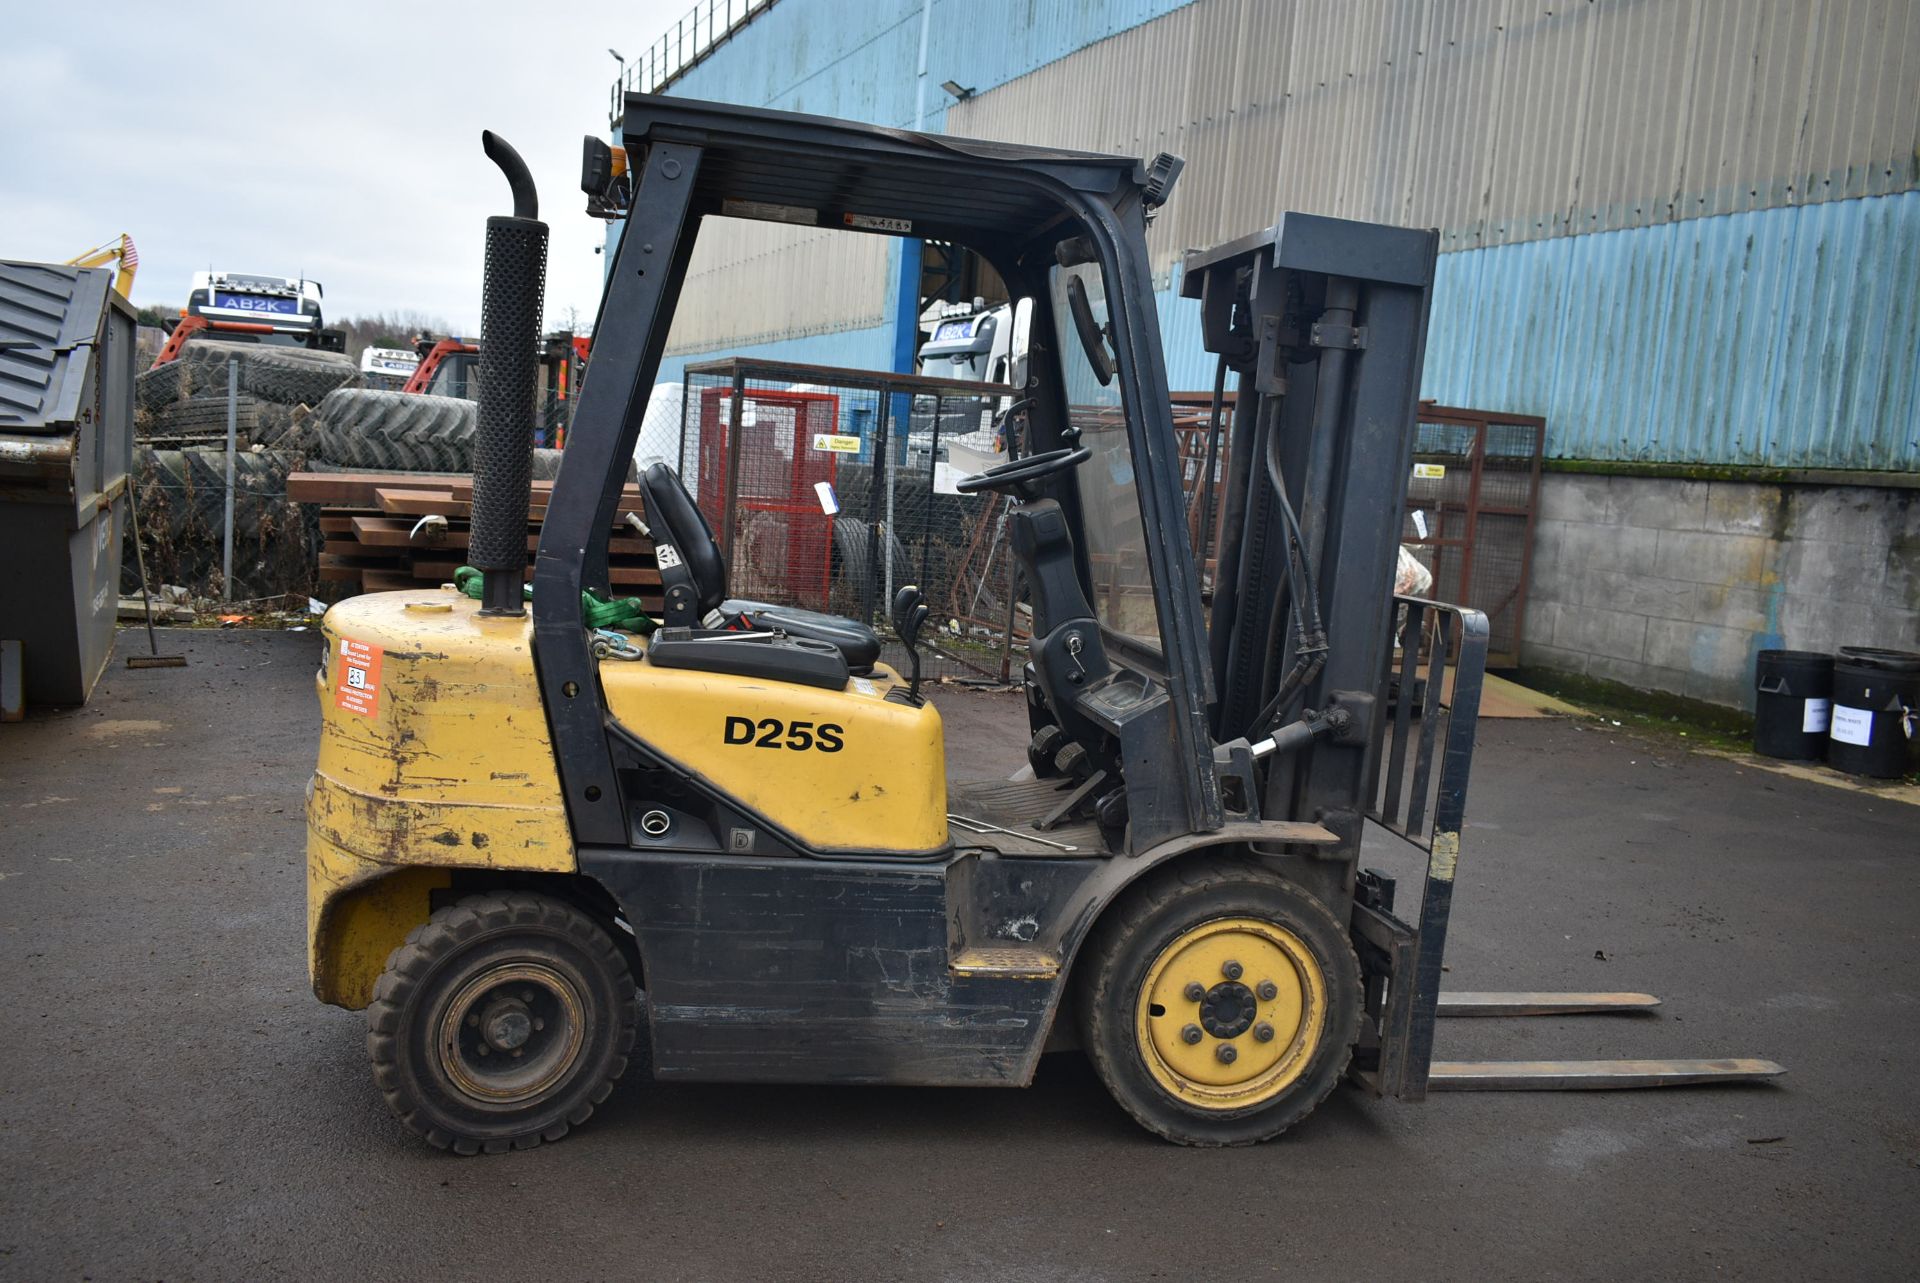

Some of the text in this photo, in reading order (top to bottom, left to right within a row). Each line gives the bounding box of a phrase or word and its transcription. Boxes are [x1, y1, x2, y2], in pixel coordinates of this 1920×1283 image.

[224, 298, 280, 312] AB2K
[940, 325, 965, 339] AB2K
[724, 716, 845, 752] D25S
